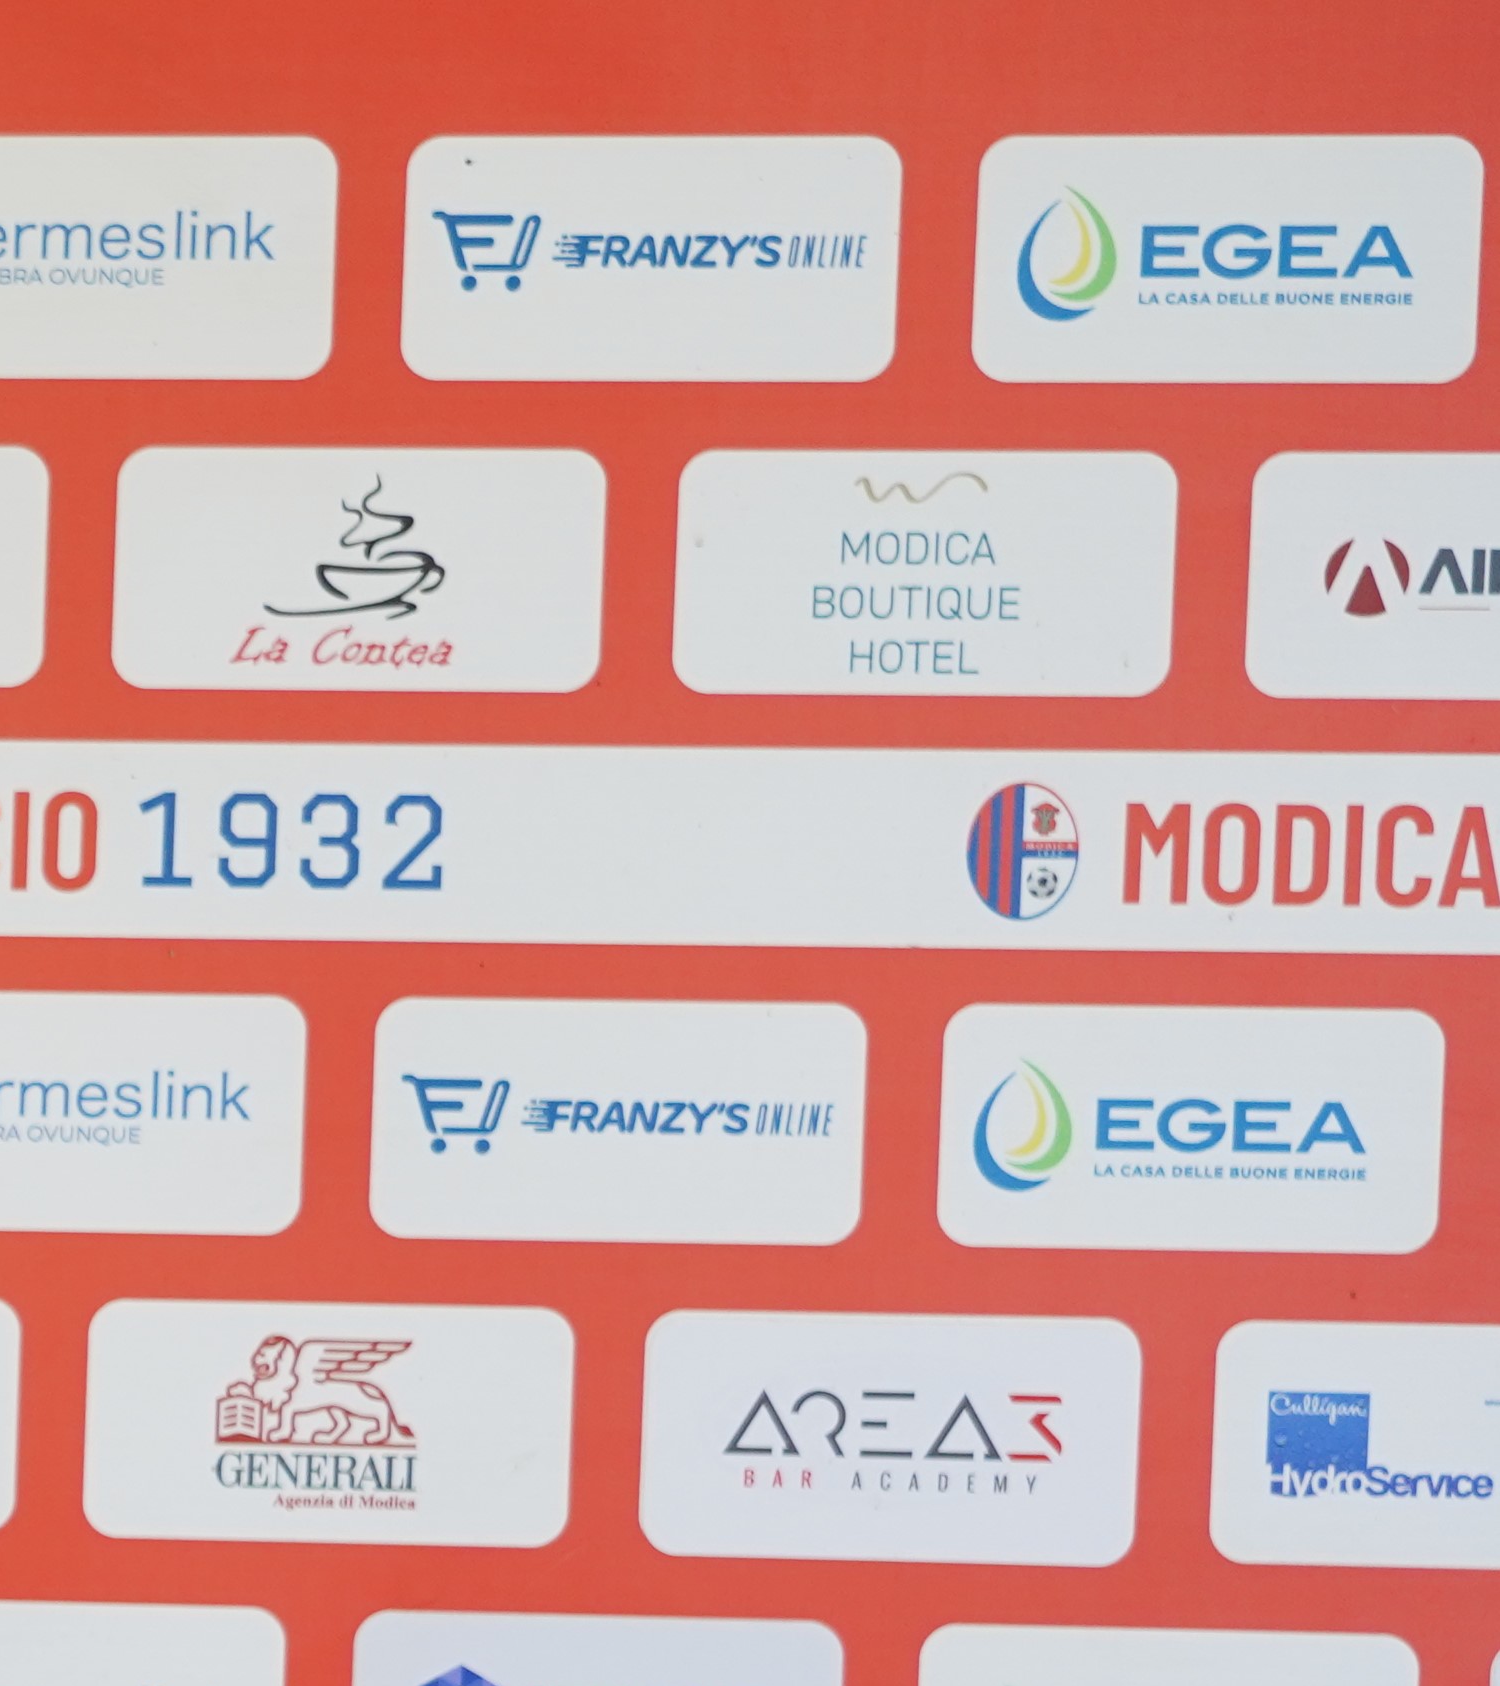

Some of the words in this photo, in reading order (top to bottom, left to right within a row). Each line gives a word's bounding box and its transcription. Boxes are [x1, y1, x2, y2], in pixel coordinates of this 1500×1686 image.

[571, 234, 783, 269] FRANZY'S
[787, 234, 868, 269] ONLINE
[1139, 223, 1413, 280] EGEA
[47, 266, 165, 289] OVUNQUE
[1137, 292, 1160, 306] LA
[1164, 291, 1212, 306] CASA
[1215, 291, 1270, 306] DELLE
[1274, 292, 1335, 306] BUONE
[1339, 292, 1414, 306] ENERGIE
[840, 530, 996, 567] MODICA
[811, 584, 1021, 621] BOUTIQUE
[230, 625, 290, 665] La
[848, 639, 980, 676] HOTEL
[138, 791, 443, 891] 1932
[1122, 802, 1500, 909] MODICA
[25, 1123, 142, 1147] OVUNQUE
[544, 1099, 751, 1136] FRANZY'S
[755, 1102, 834, 1137] ONLINE
[1095, 1097, 1366, 1155] EGEA
[1092, 1164, 1115, 1178] LA
[1119, 1164, 1166, 1178] CASA
[1171, 1164, 1224, 1180] DELLE
[1228, 1166, 1289, 1180] BUONE
[1293, 1166, 1367, 1182] ENERGIE
[214, 1451, 417, 1492] GENERALI
[743, 1467, 813, 1489] BAR
[850, 1470, 1038, 1495] ACADEMY
